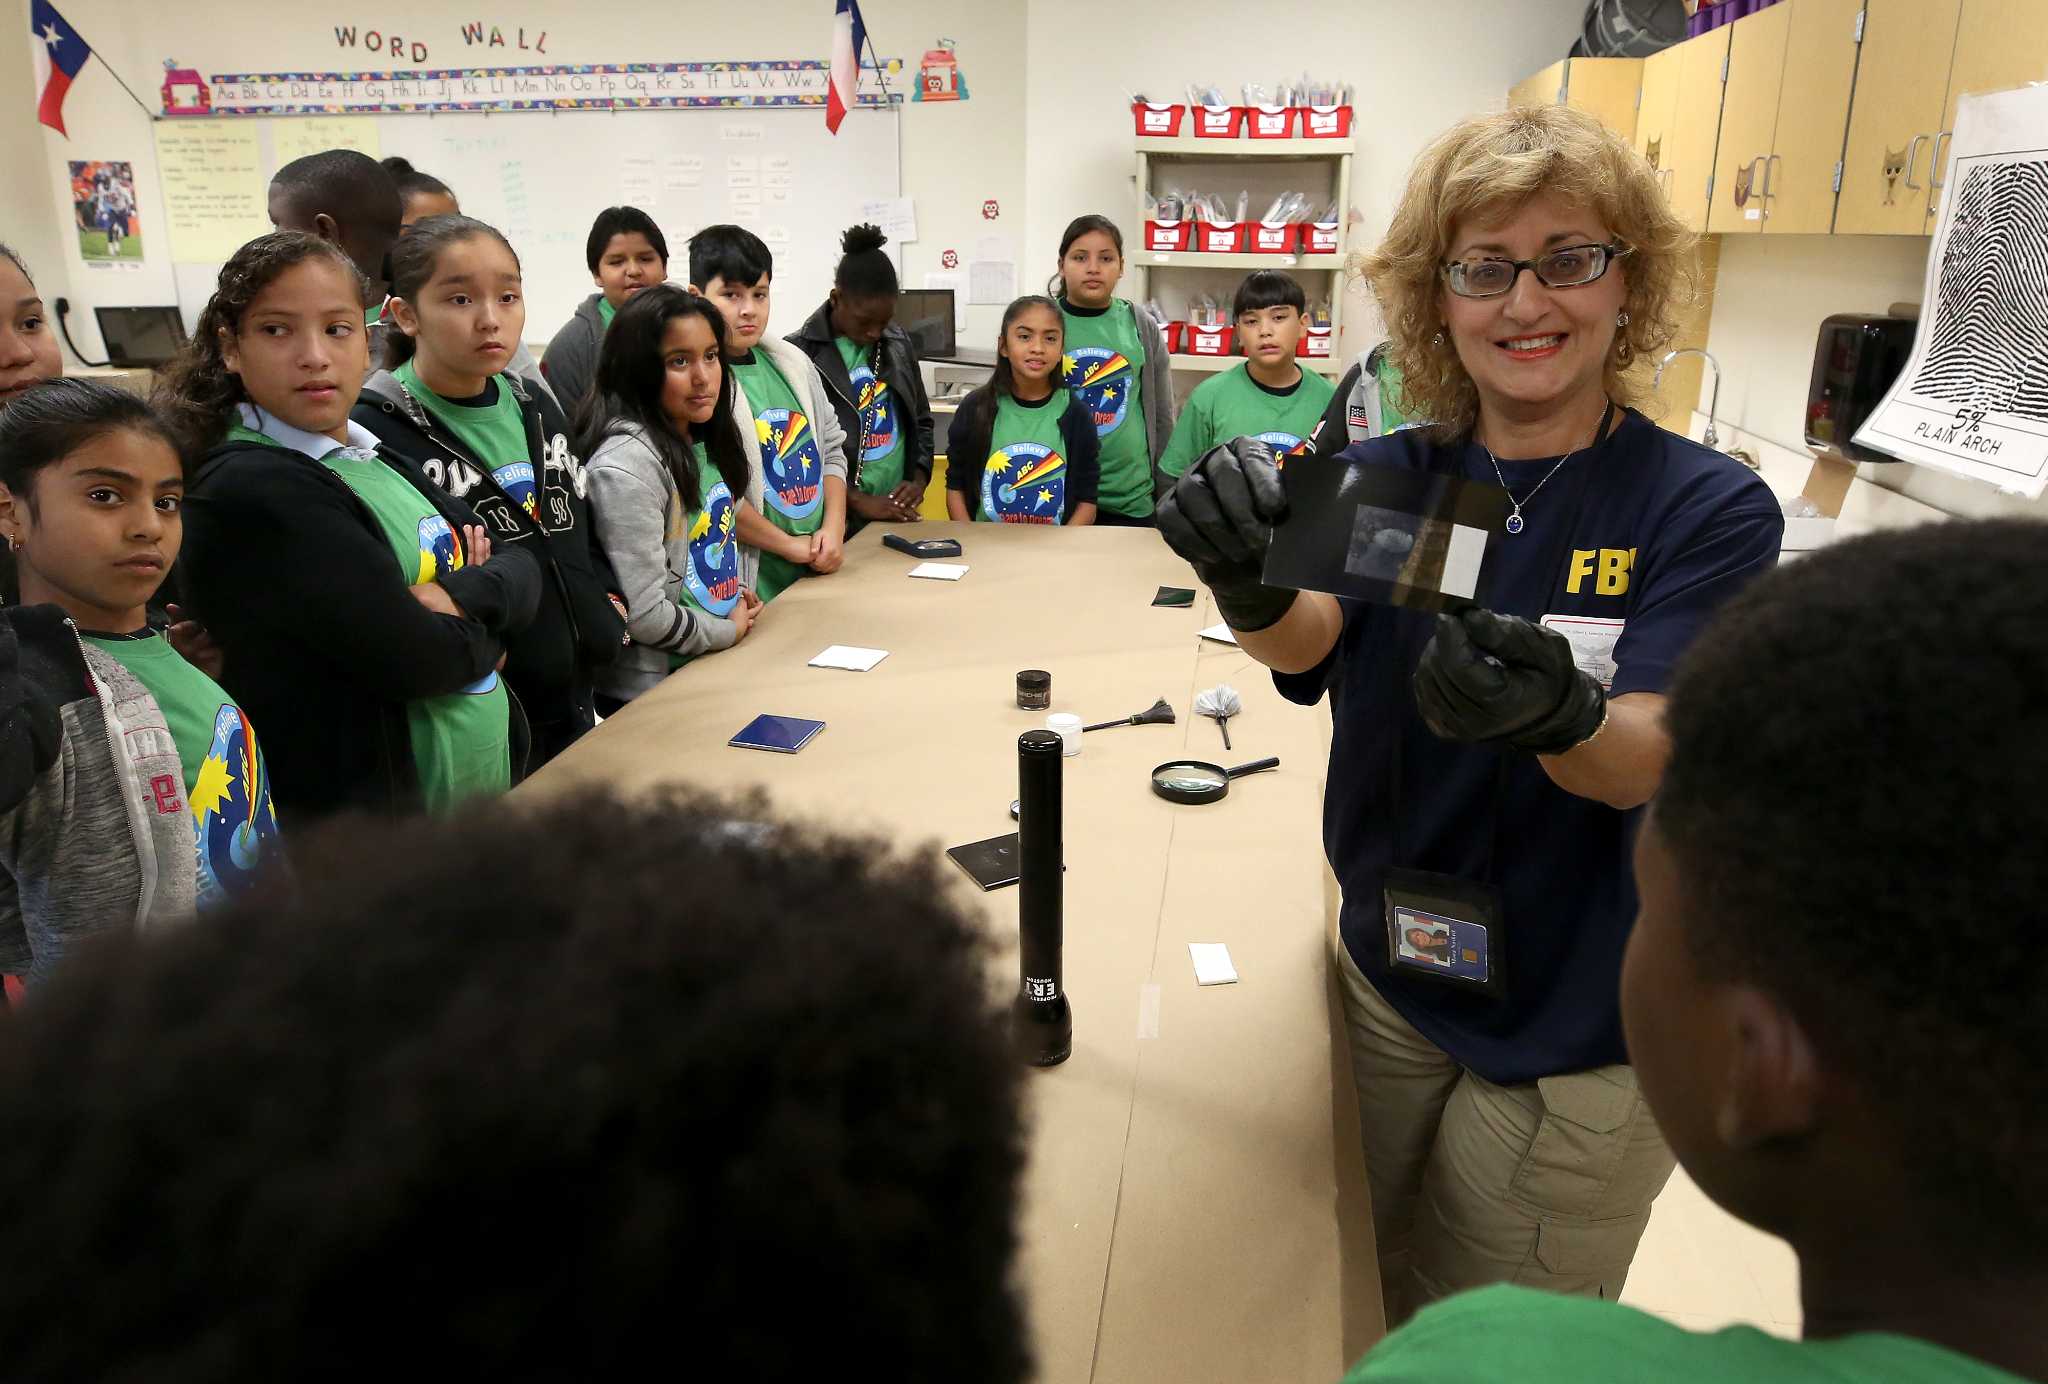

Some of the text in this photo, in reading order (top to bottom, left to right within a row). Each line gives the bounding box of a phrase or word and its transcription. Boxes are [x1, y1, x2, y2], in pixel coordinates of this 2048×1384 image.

[334, 21, 547, 63] WORD WALL
[217, 85, 235, 99] Aa
[242, 84, 258, 98] Bb
[266, 84, 283, 99] Cc
[291, 83, 309, 98] Dd
[318, 82, 334, 97] Ee
[342, 81, 354, 97] Ff
[364, 81, 384, 104] Gg
[392, 81, 409, 96] Hh
[417, 80, 427, 95] Ii
[439, 79, 451, 100] Jj
[463, 79, 479, 94] Kk
[491, 77, 504, 93] Ll
[513, 77, 538, 93] Mm
[546, 77, 566, 92] Nn
[570, 75, 592, 91] Oo
[600, 74, 616, 95] Pp
[624, 74, 648, 96] Qq
[656, 73, 672, 89] Rr
[680, 74, 695, 88] Ss
[706, 73, 718, 88] Tt
[730, 73, 748, 88] Uu
[757, 72, 775, 87] Vv
[783, 71, 811, 87] Ww
[1083, 361, 1100, 380] ABC
[1951, 408, 1987, 432] 5%
[1012, 444, 1046, 456] Believe
[1261, 432, 1296, 445] Believe
[1914, 422, 2002, 456] PLAIN ARCH
[1016, 460, 1034, 480] ABC
[487, 496, 567, 532] 18 98
[718, 505, 732, 535] ABC
[1025, 982, 1055, 996] ERT
